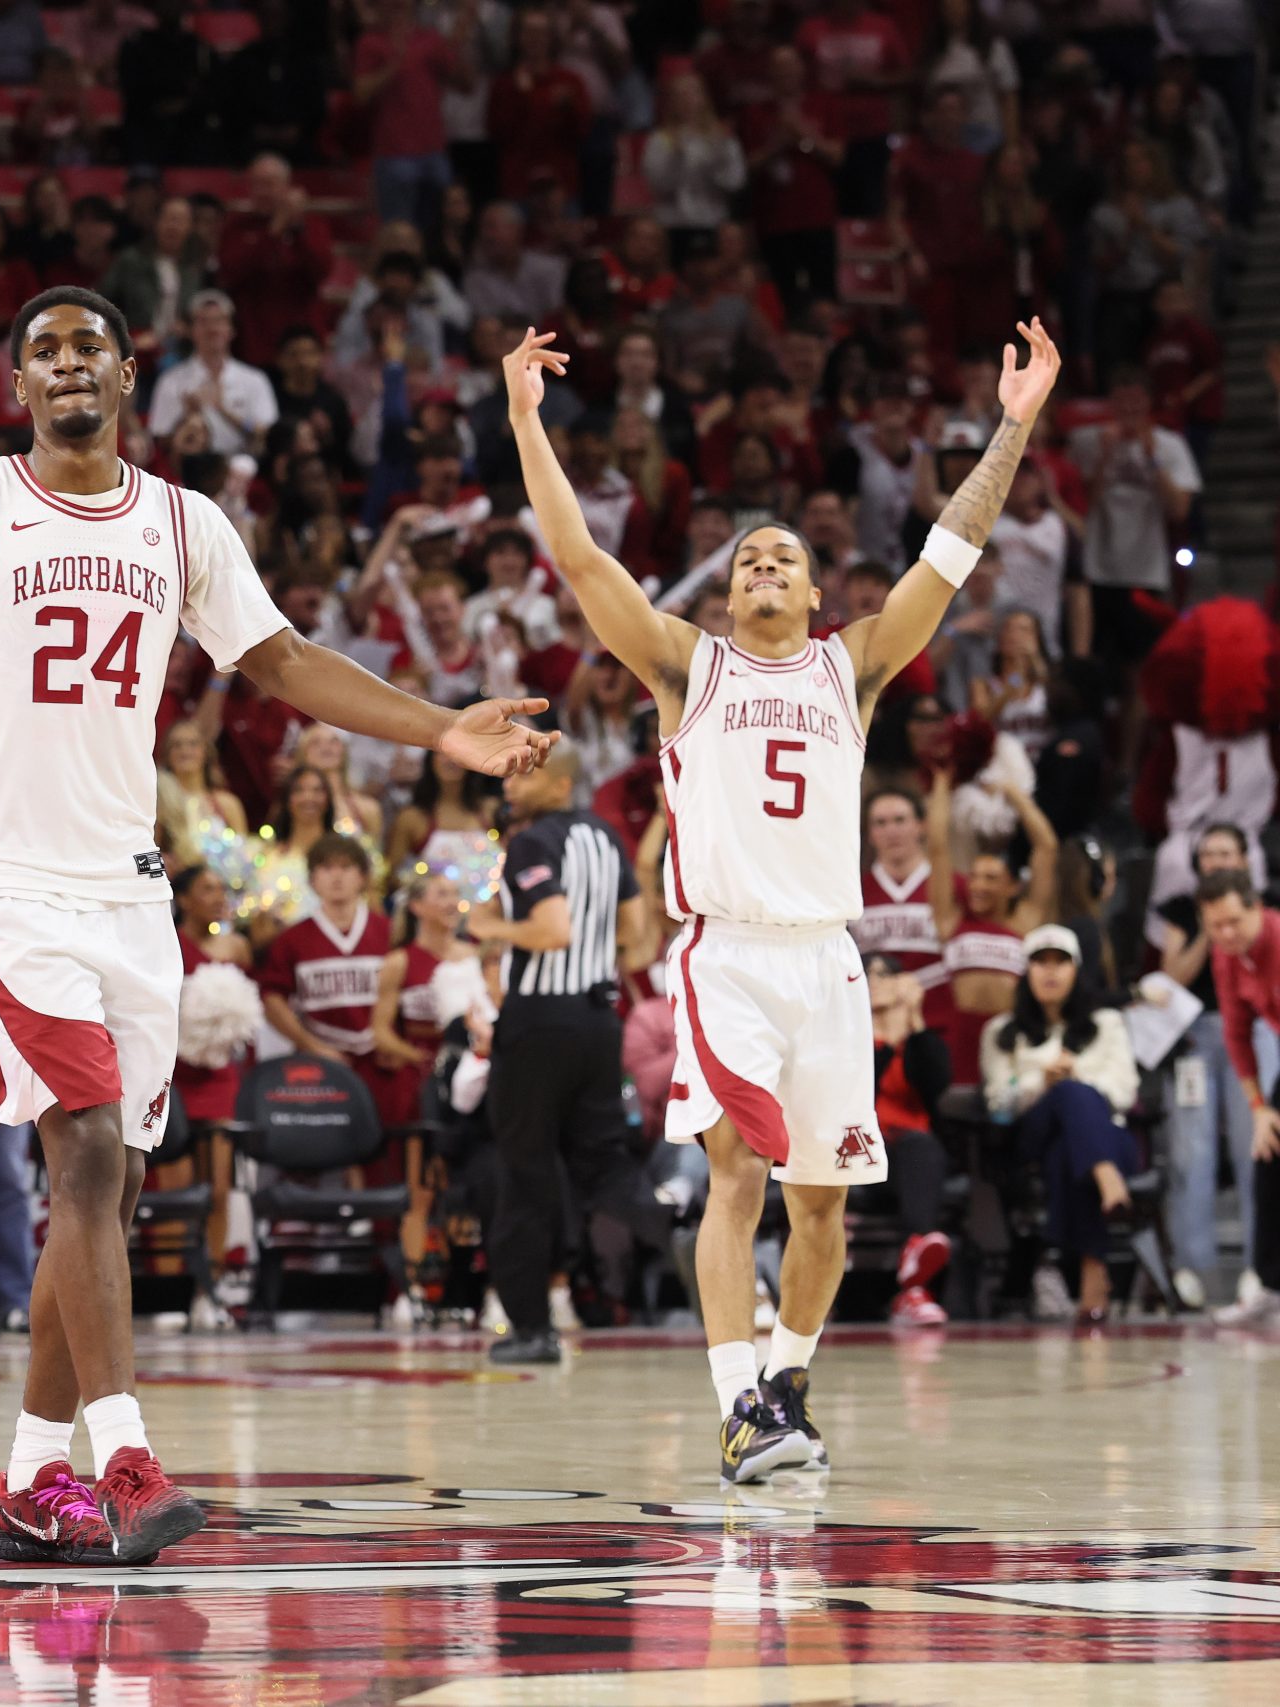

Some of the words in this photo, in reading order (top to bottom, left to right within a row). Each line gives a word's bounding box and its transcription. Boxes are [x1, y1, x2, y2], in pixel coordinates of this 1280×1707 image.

[144, 529, 160, 545] SEC
[13, 556, 167, 614] RAZORBACKS
[32, 606, 144, 709] 24
[723, 698, 839, 745] RAZORBACKS
[763, 739, 806, 819] 5
